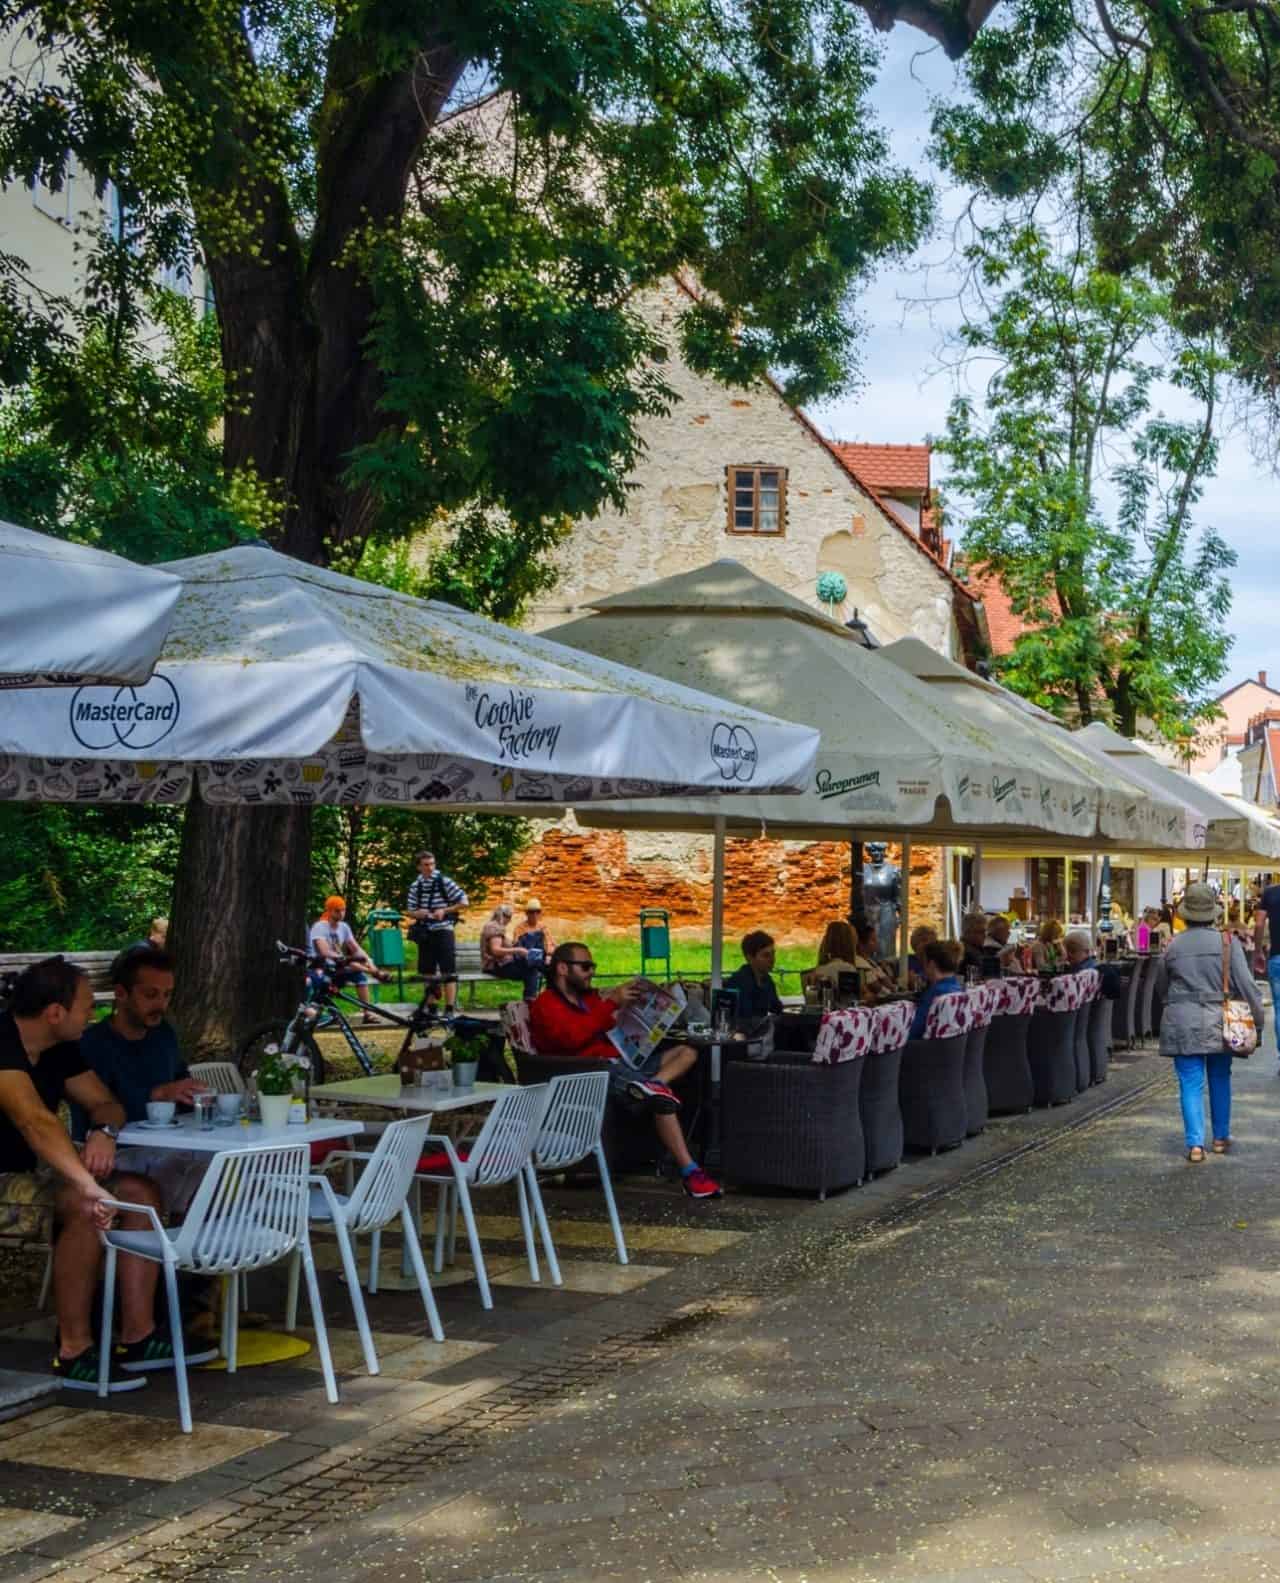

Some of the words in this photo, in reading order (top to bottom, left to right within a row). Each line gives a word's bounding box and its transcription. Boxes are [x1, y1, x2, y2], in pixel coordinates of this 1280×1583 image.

[75, 702, 174, 721] MasterCard
[474, 689, 536, 728] Cookie
[499, 722, 562, 760] Factory
[713, 744, 756, 763] MasterCard
[815, 769, 880, 800] Staropramen
